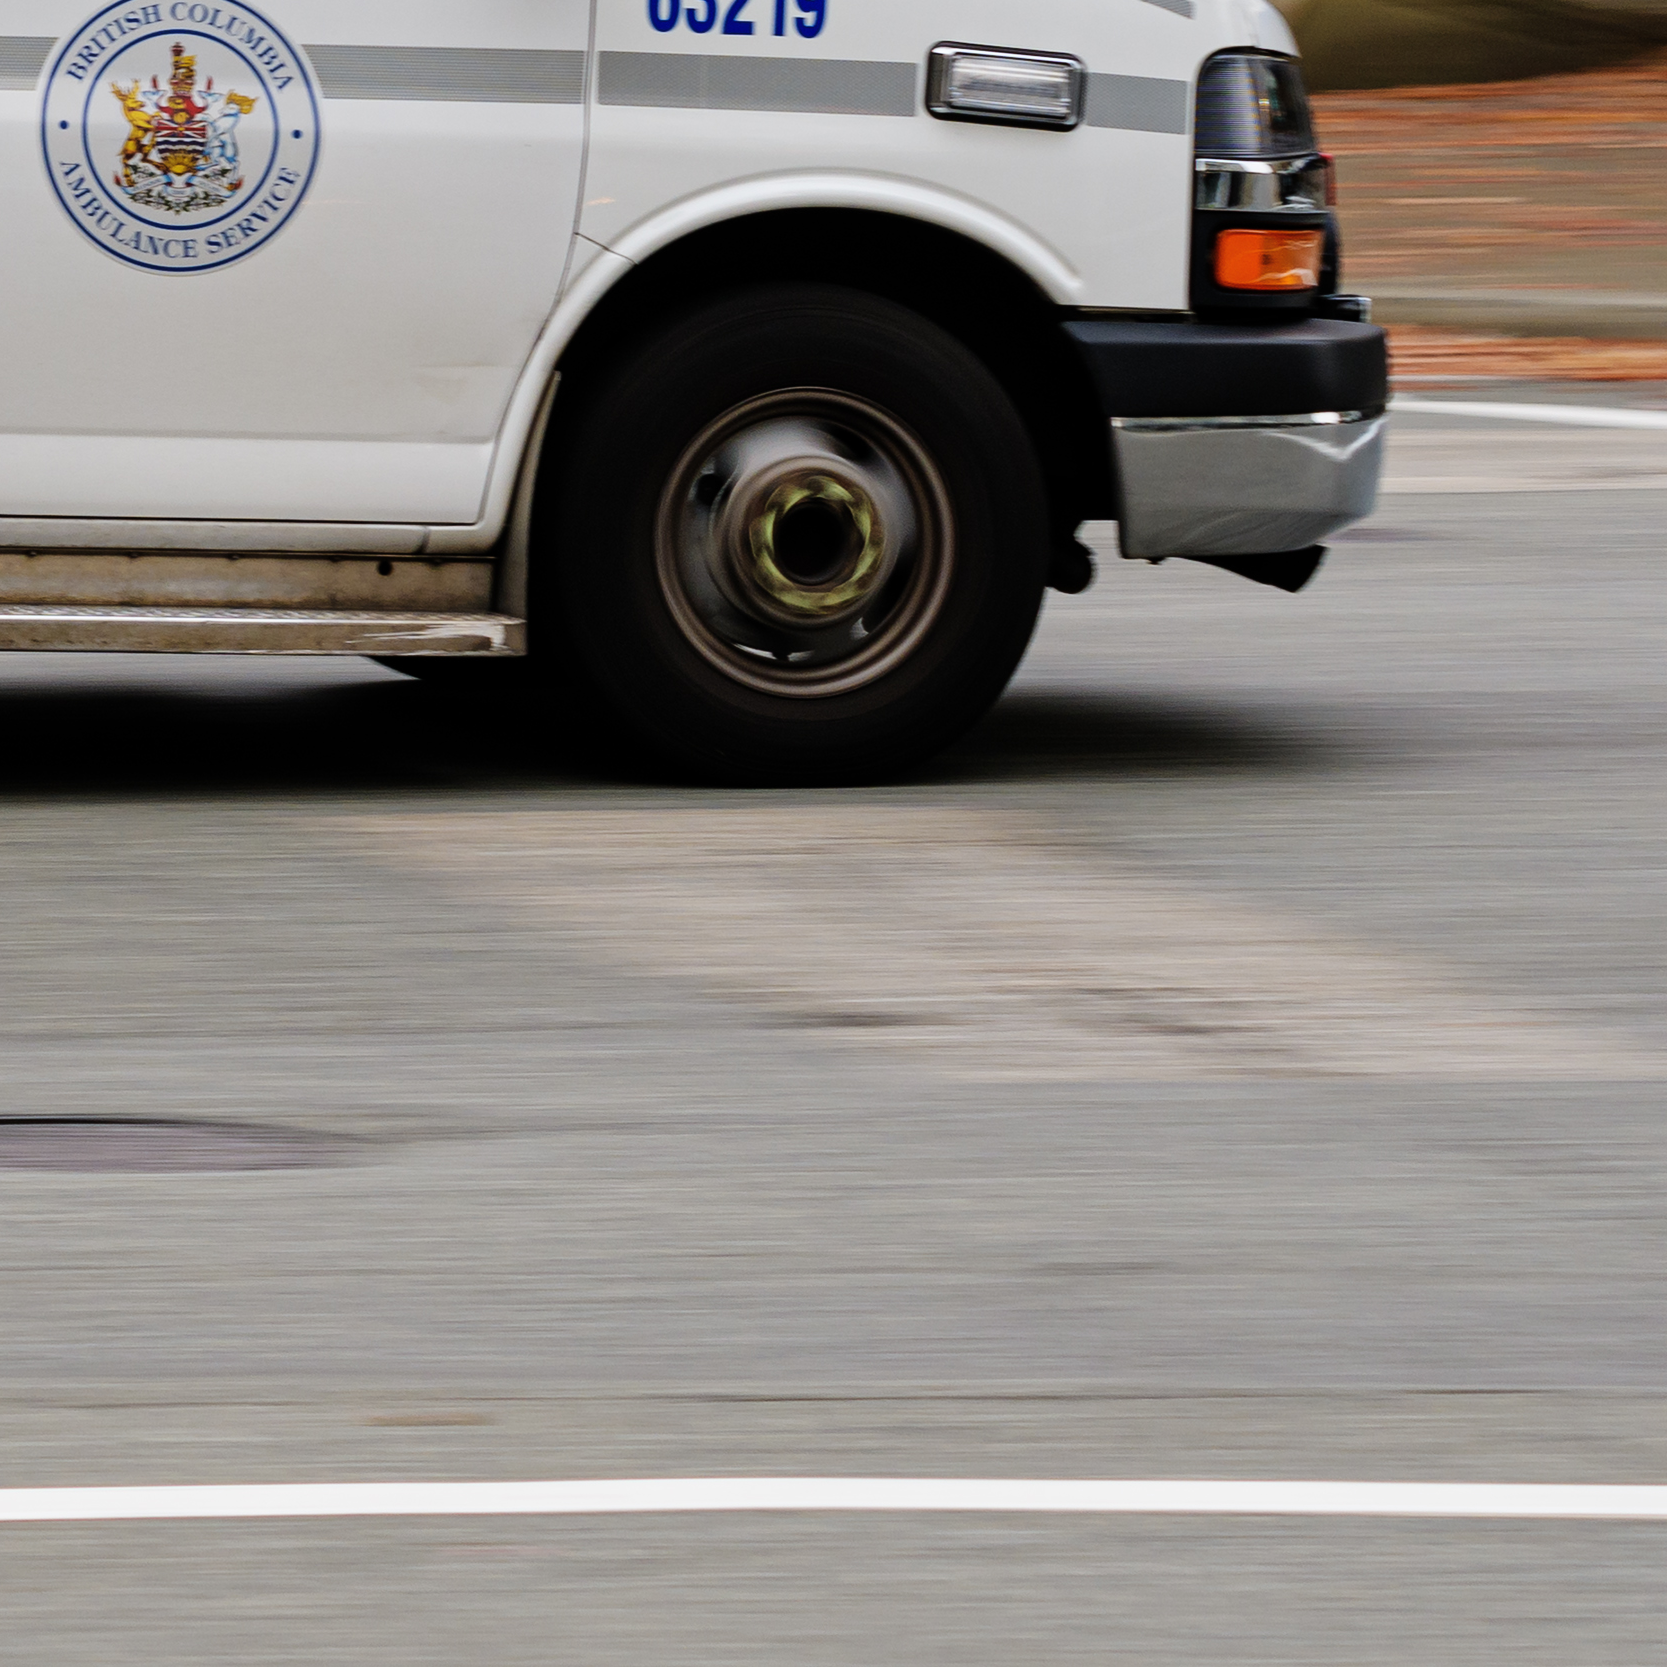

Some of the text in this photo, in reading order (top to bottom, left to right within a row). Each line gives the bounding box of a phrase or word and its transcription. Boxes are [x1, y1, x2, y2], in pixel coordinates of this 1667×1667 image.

[66, 1, 295, 91] BRITISH COLUMBIA
[59, 160, 301, 258] AMBULANCE SERVICE
